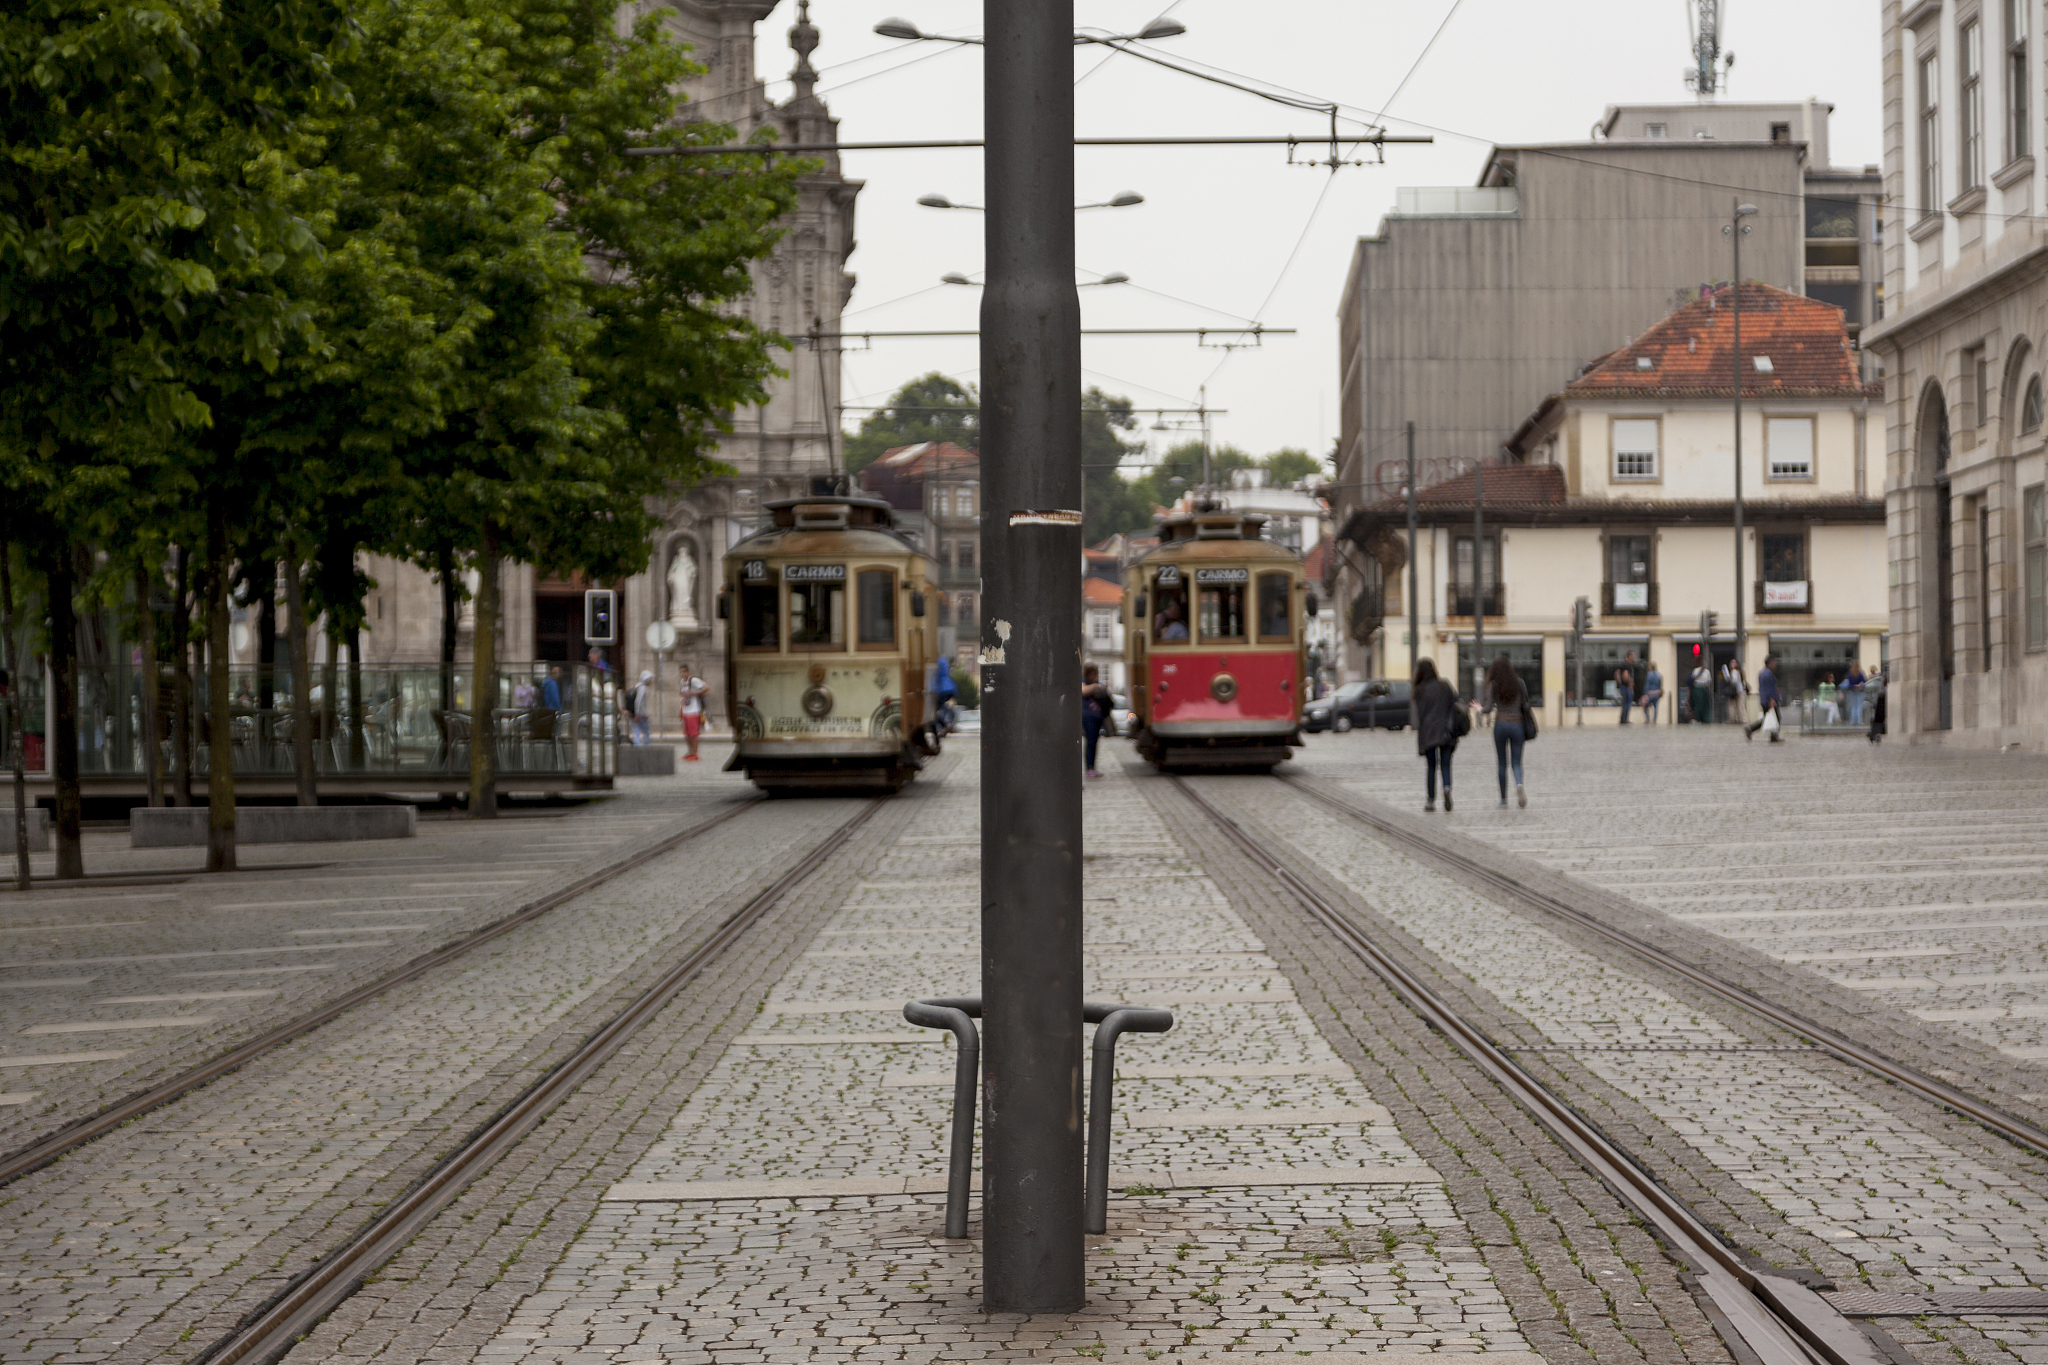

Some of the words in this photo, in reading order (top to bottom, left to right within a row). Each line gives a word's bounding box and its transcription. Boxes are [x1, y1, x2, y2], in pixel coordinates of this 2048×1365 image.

[745, 561, 763, 577] 18
[787, 565, 844, 578] CARMO
[1158, 566, 1177, 579] 22
[1197, 569, 1248, 580] CARMO
